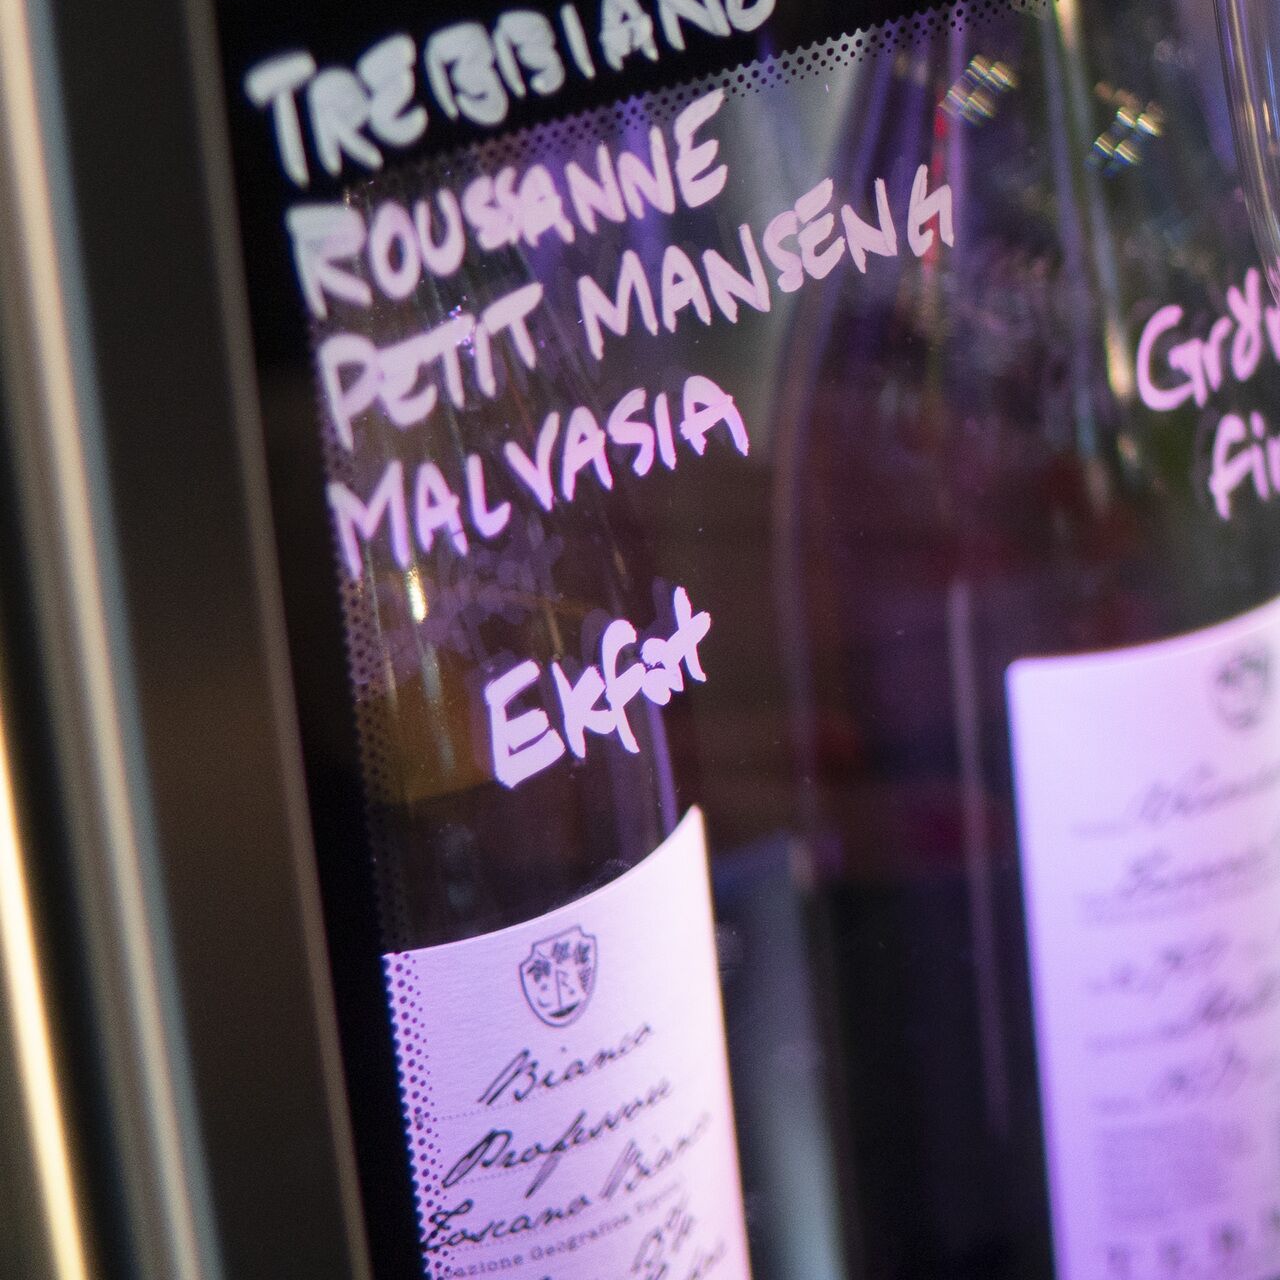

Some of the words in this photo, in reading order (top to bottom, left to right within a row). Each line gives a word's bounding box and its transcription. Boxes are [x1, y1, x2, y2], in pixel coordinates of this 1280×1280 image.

[317, 282, 545, 451] PETIT
[576, 163, 956, 361] MANSENG
[326, 374, 750, 579] MALVASIA
